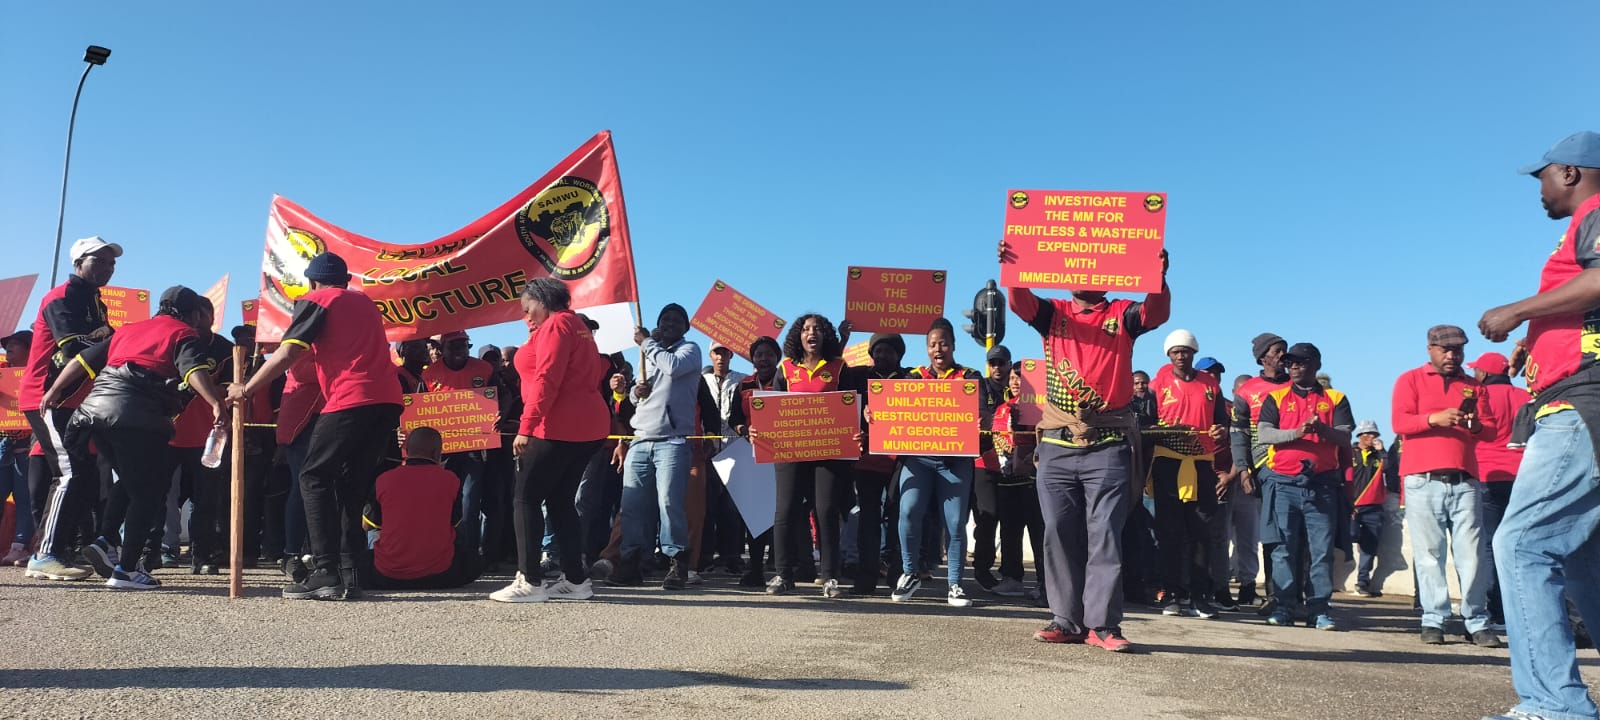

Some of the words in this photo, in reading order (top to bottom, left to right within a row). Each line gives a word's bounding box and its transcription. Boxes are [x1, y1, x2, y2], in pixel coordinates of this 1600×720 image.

[538, 190, 579, 209] SAMWU
[1045, 196, 1126, 207] INVESTIGATE
[1045, 211, 1069, 221] THE
[1073, 212, 1093, 221] MM
[1098, 212, 1124, 223] FOR
[1007, 225, 1075, 236] FRUITLESS
[1079, 227, 1087, 237] &
[1091, 228, 1161, 239] WASTEFUL
[1038, 241, 1126, 254] EXPENDITURE
[1065, 258, 1096, 268] WITH
[881, 273, 912, 283] STOP
[1019, 272, 1087, 284] IMMEDIATE
[1092, 275, 1142, 286] EFFECT
[374, 270, 527, 324] RUCTURE
[884, 288, 907, 298] THE
[848, 301, 885, 312] UNION
[888, 303, 942, 314] BASHING
[880, 318, 909, 328] NOW
[894, 382, 924, 392] STOP
[928, 383, 951, 393] THE
[1058, 358, 1108, 410] SAMW
[423, 393, 451, 403] STOP
[454, 391, 474, 400] THE
[780, 398, 805, 406] STOP
[887, 397, 960, 407] UNILATERAL
[417, 402, 482, 416] UNILATERAL
[779, 407, 829, 416] VINDICTIVE
[405, 414, 494, 430] RESTRUCTURING
[873, 411, 973, 422] RESTRUCTURING
[773, 417, 835, 428] DISCIPLINARY
[758, 430, 812, 439] PROCESSES
[814, 426, 854, 436] AGAINST
[889, 426, 904, 435] AT
[907, 426, 958, 437] GEORGE
[442, 439, 488, 450] CIPALITY
[795, 438, 840, 448] MEMBERS
[883, 440, 964, 451] MUNICIPALITY
[795, 448, 841, 458] WORKERS
